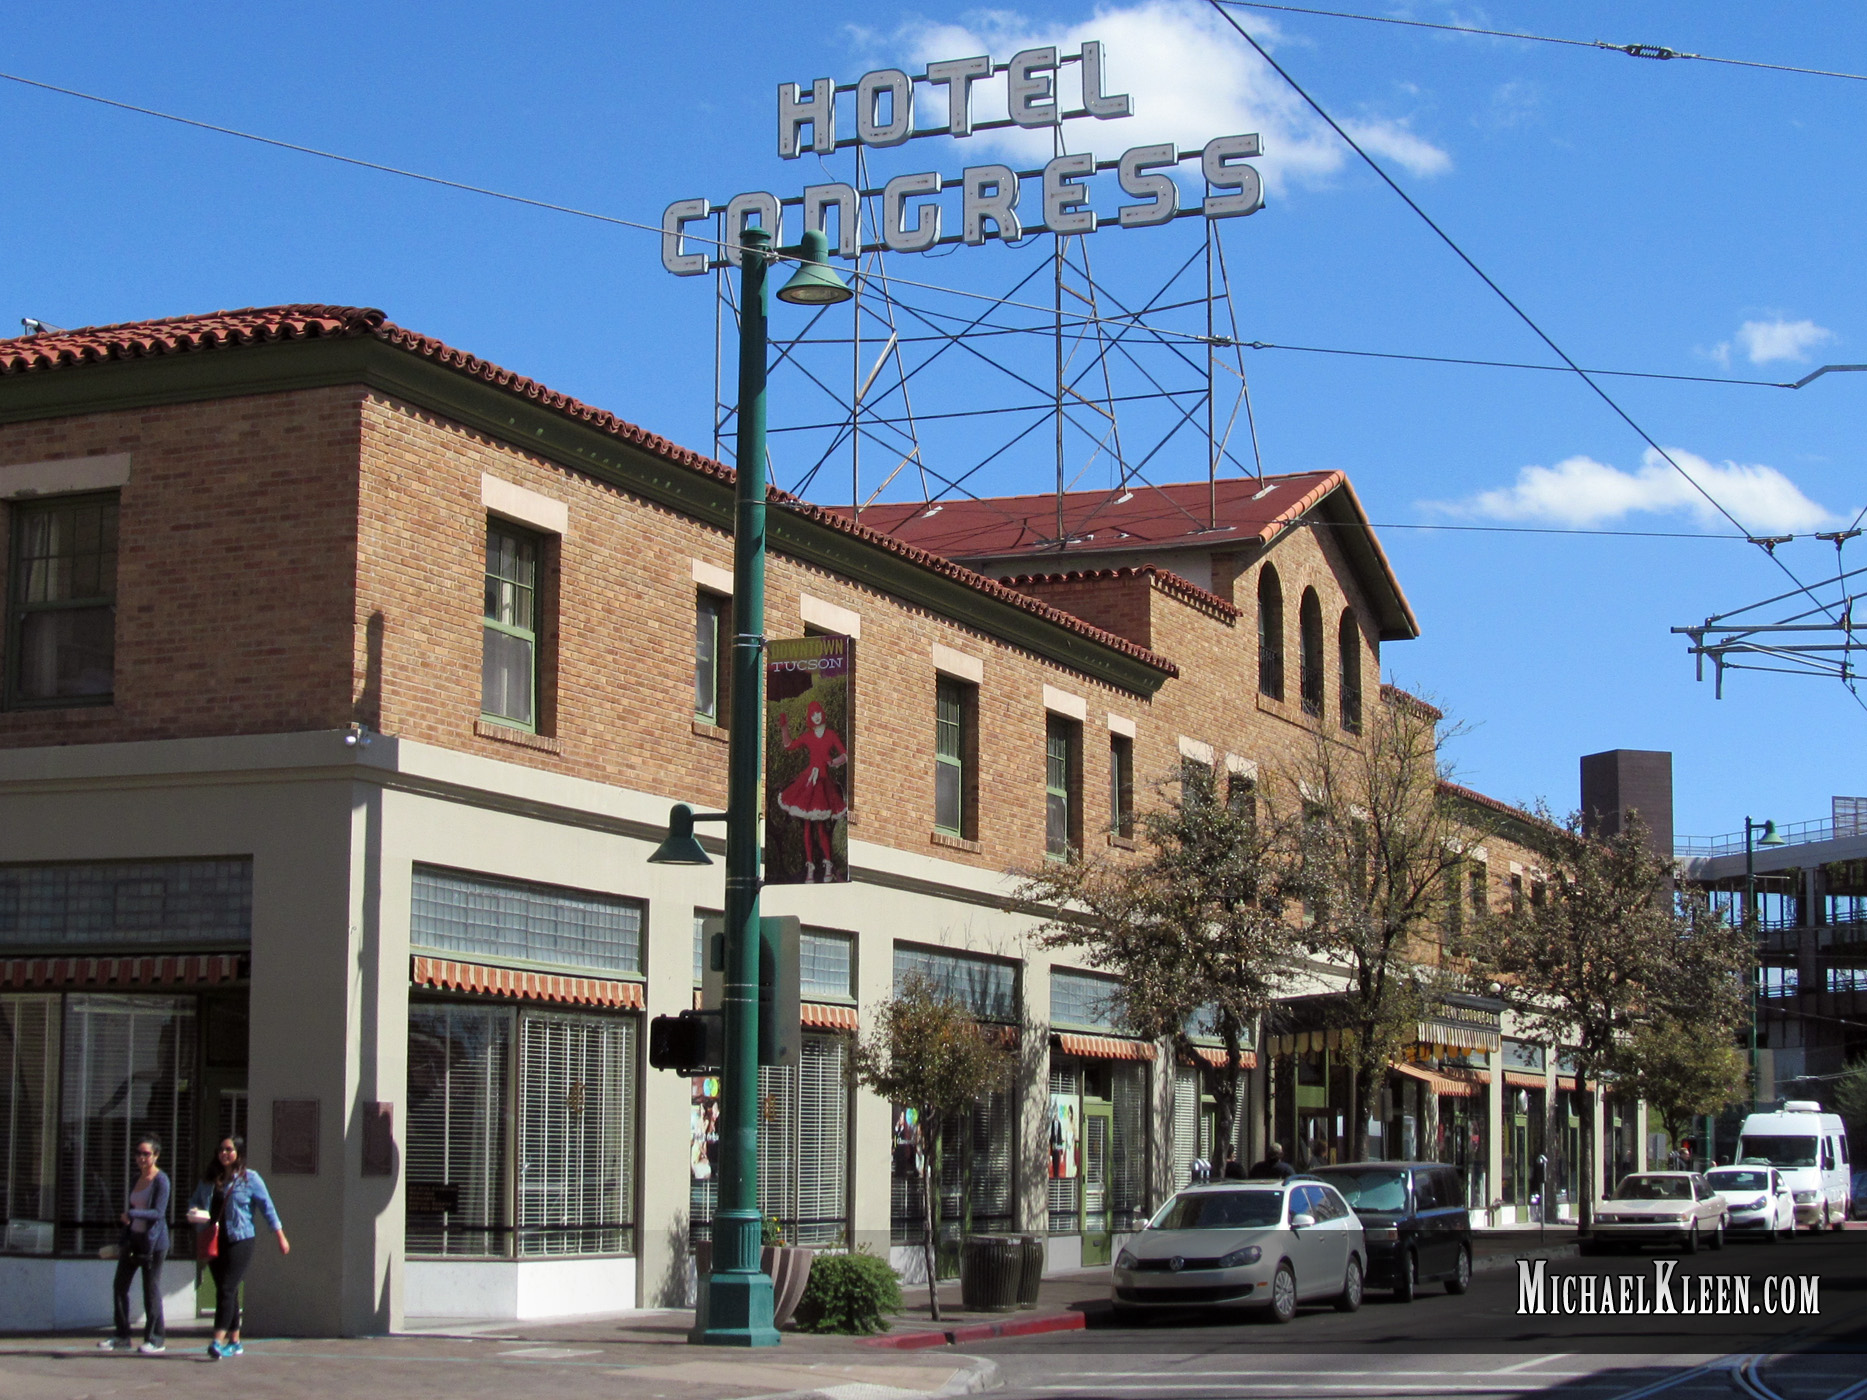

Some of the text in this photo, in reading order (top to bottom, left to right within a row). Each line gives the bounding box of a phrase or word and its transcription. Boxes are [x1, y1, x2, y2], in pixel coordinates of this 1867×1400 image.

[777, 40, 1134, 160] HOTEL
[661, 133, 1264, 277] CONGRESS
[771, 639, 844, 659] DOWNTOWN
[771, 657, 844, 672] TUCSON
